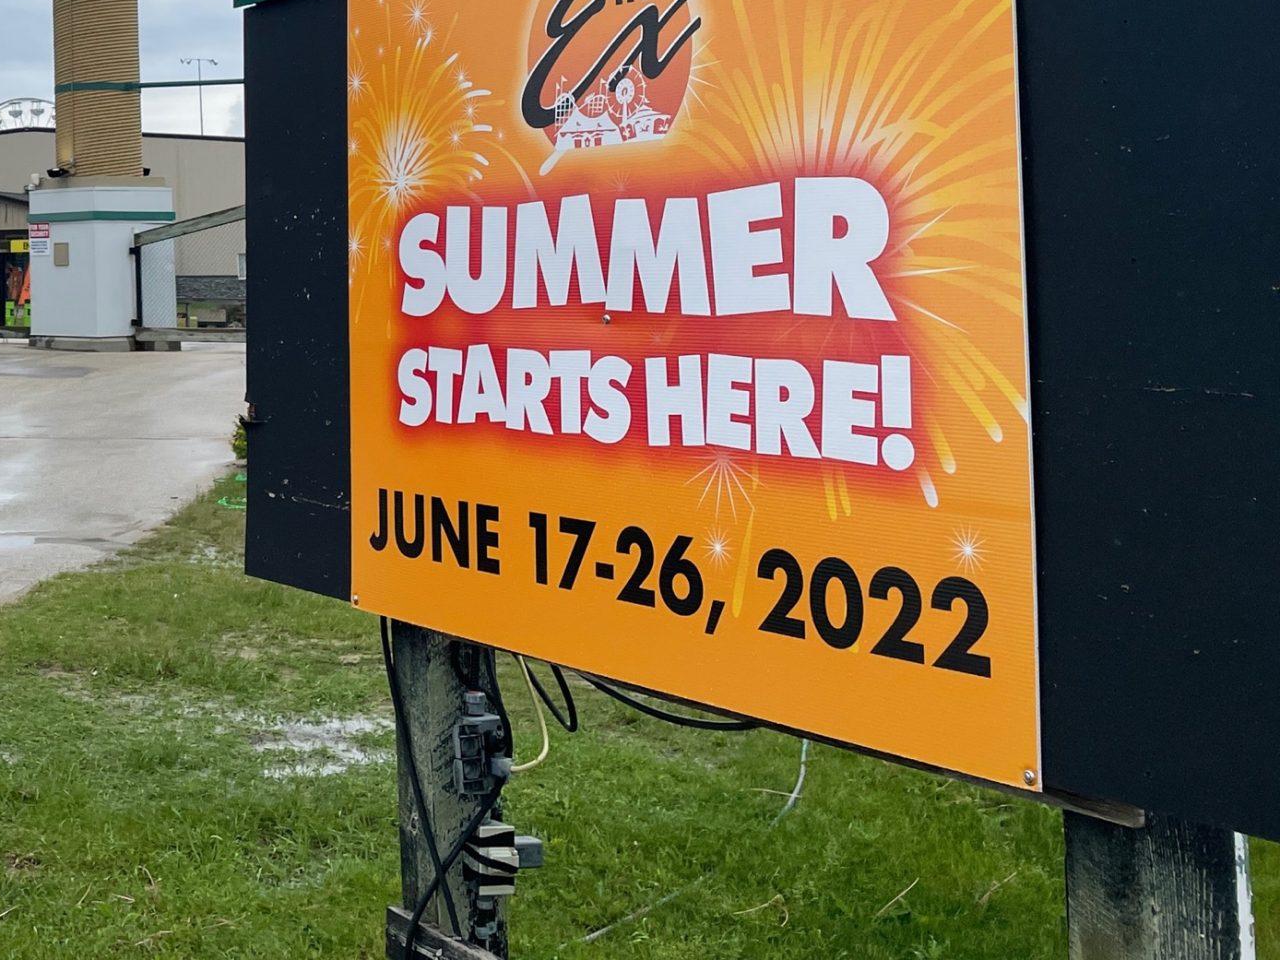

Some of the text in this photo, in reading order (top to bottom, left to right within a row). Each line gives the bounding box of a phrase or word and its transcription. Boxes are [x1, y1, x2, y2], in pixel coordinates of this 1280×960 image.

[397, 176, 898, 322] SUMMER
[396, 343, 916, 472] STARTS HERE!
[369, 487, 993, 680] JUNE 17-26, 2022
